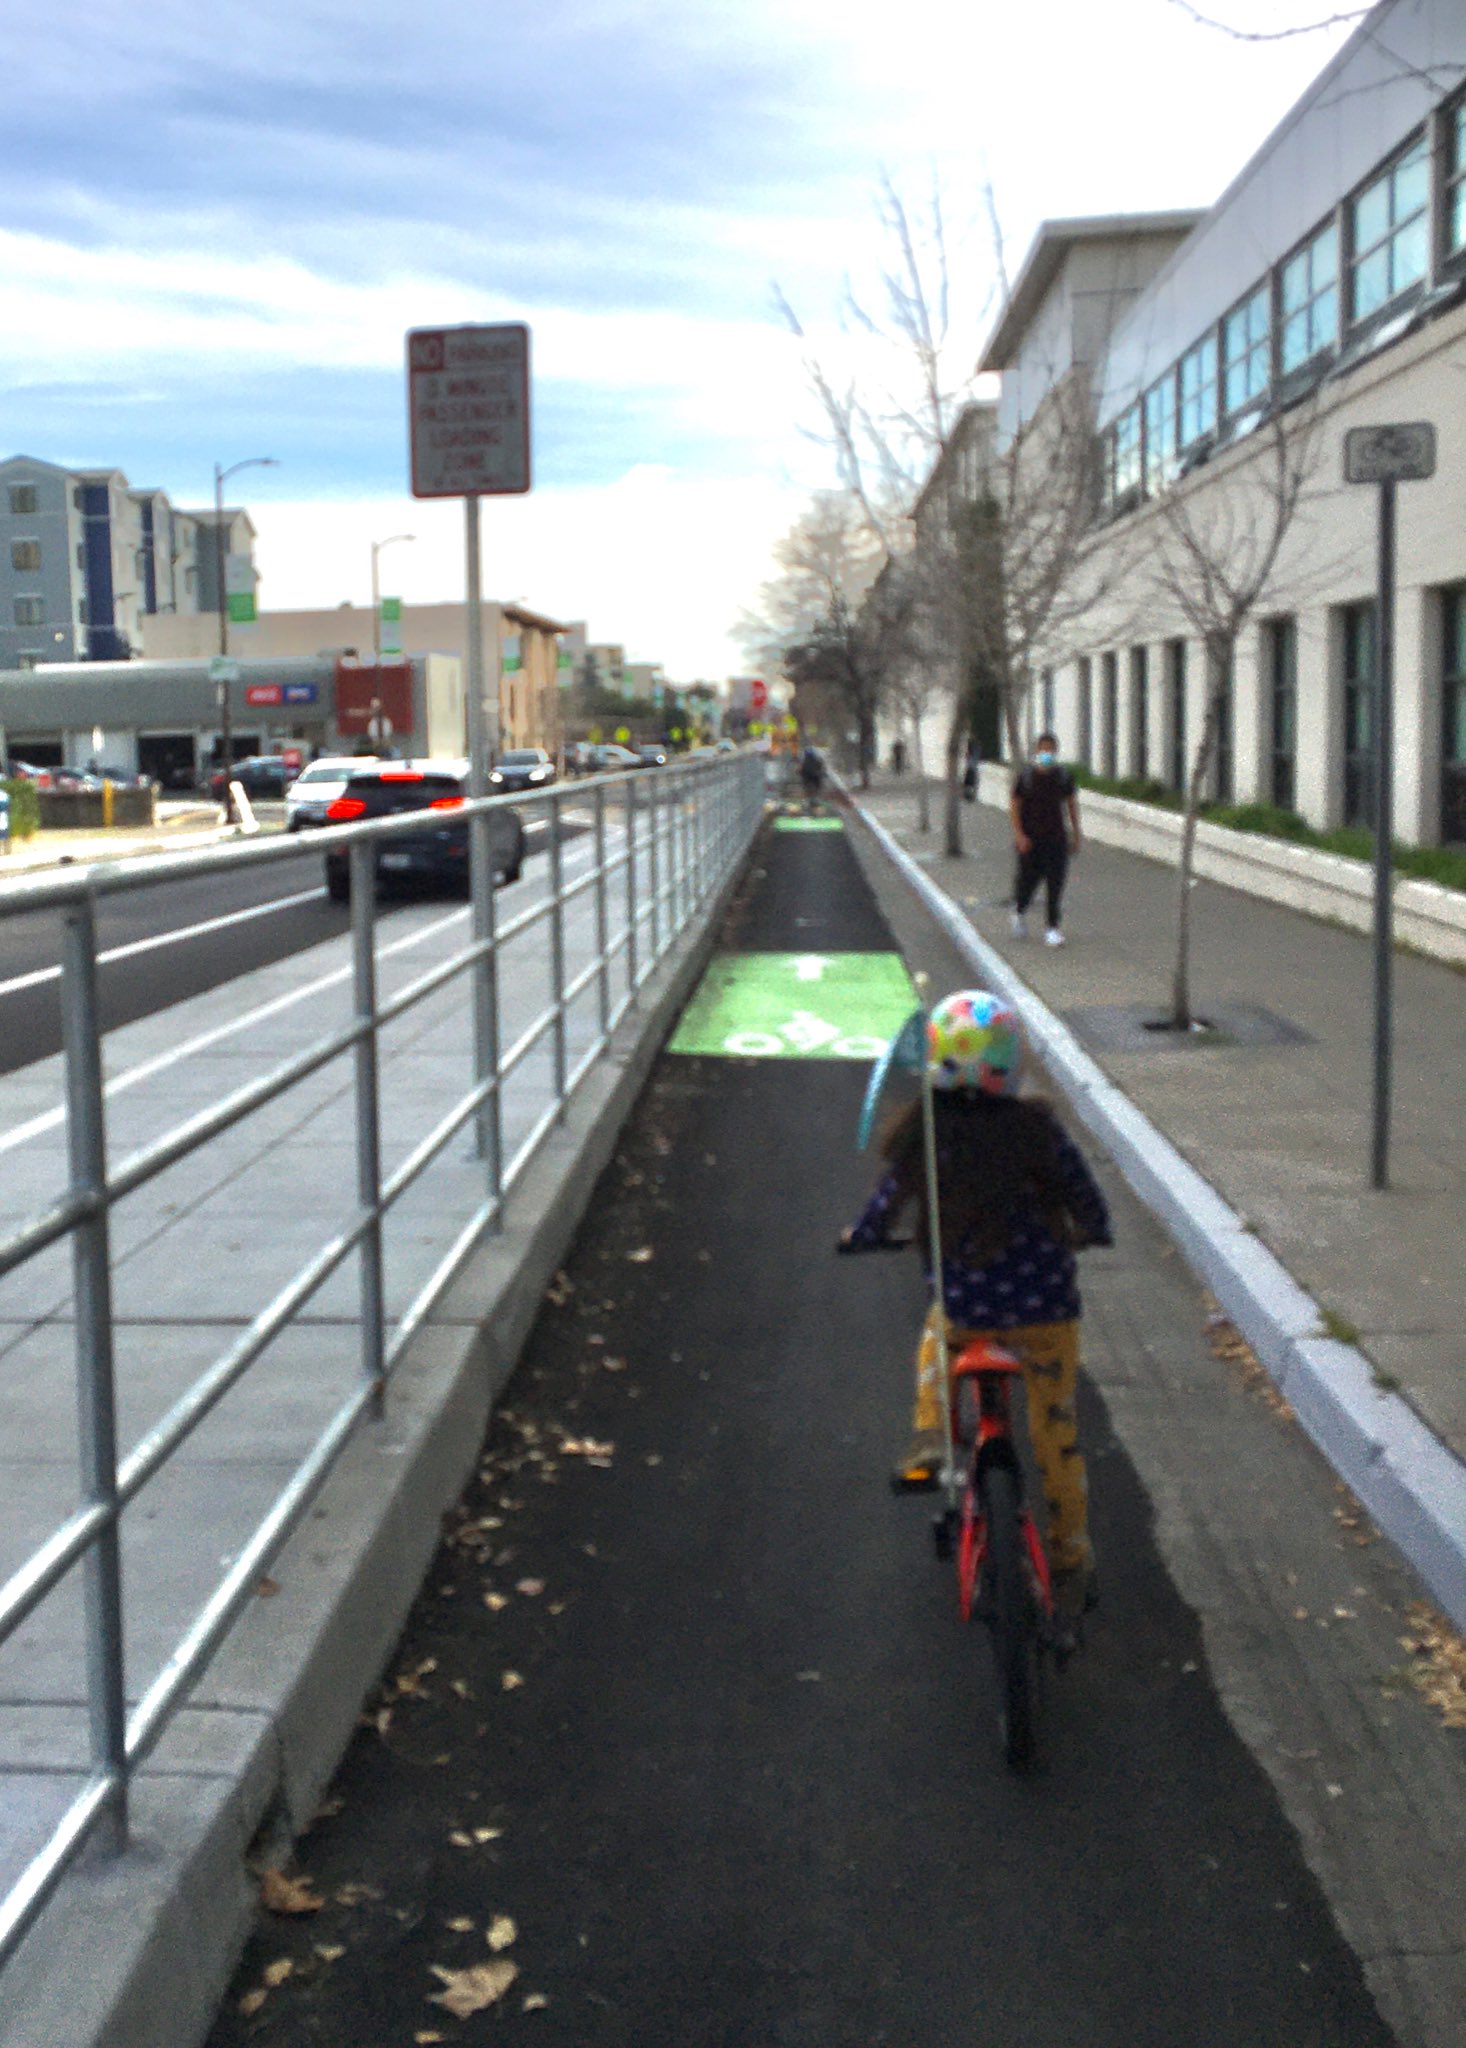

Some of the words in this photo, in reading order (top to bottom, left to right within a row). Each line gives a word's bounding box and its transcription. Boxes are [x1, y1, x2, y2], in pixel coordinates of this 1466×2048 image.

[419, 399, 516, 423] PASSENGER
[430, 426, 501, 449] LOADING
[444, 451, 485, 471] ZONE
